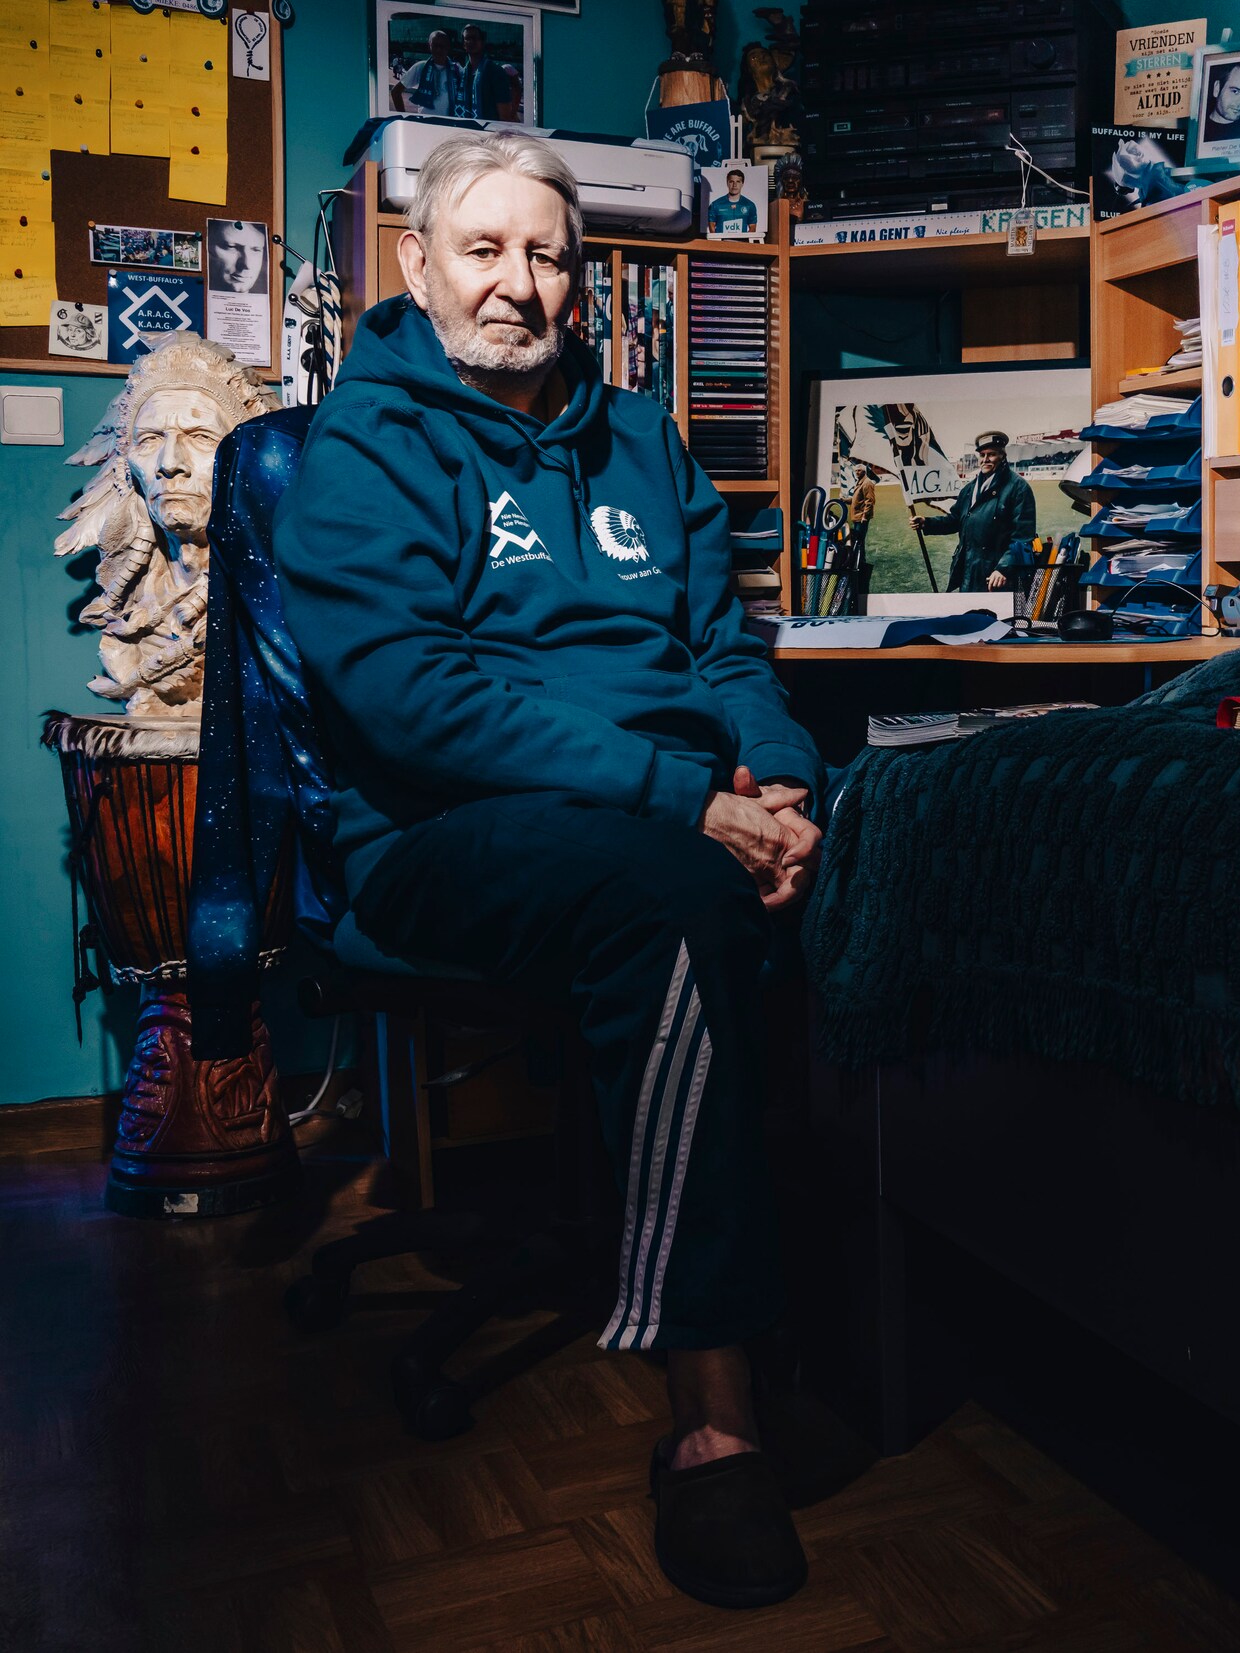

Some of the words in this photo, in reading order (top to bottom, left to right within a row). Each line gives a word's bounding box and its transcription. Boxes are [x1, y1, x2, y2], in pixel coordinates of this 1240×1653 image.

[1129, 32, 1195, 52] VRIENDEN
[1136, 55, 1182, 71] STERREN
[1137, 91, 1181, 110] ALTIJD
[670, 121, 687, 135] ARE
[688, 119, 720, 142] BUFFALO
[1092, 127, 1135, 137] BUFFALOO
[1166, 133, 1185, 141] LIFE
[850, 229, 876, 243] KAA
[879, 227, 910, 241] GENT
[127, 274, 183, 284] WEST-BUFFALO'S
[138, 310, 173, 319] A.R.A.G.
[138, 320, 173, 330] K.A.A.G.
[491, 560, 505, 570] De
[639, 569, 652, 578] aan
